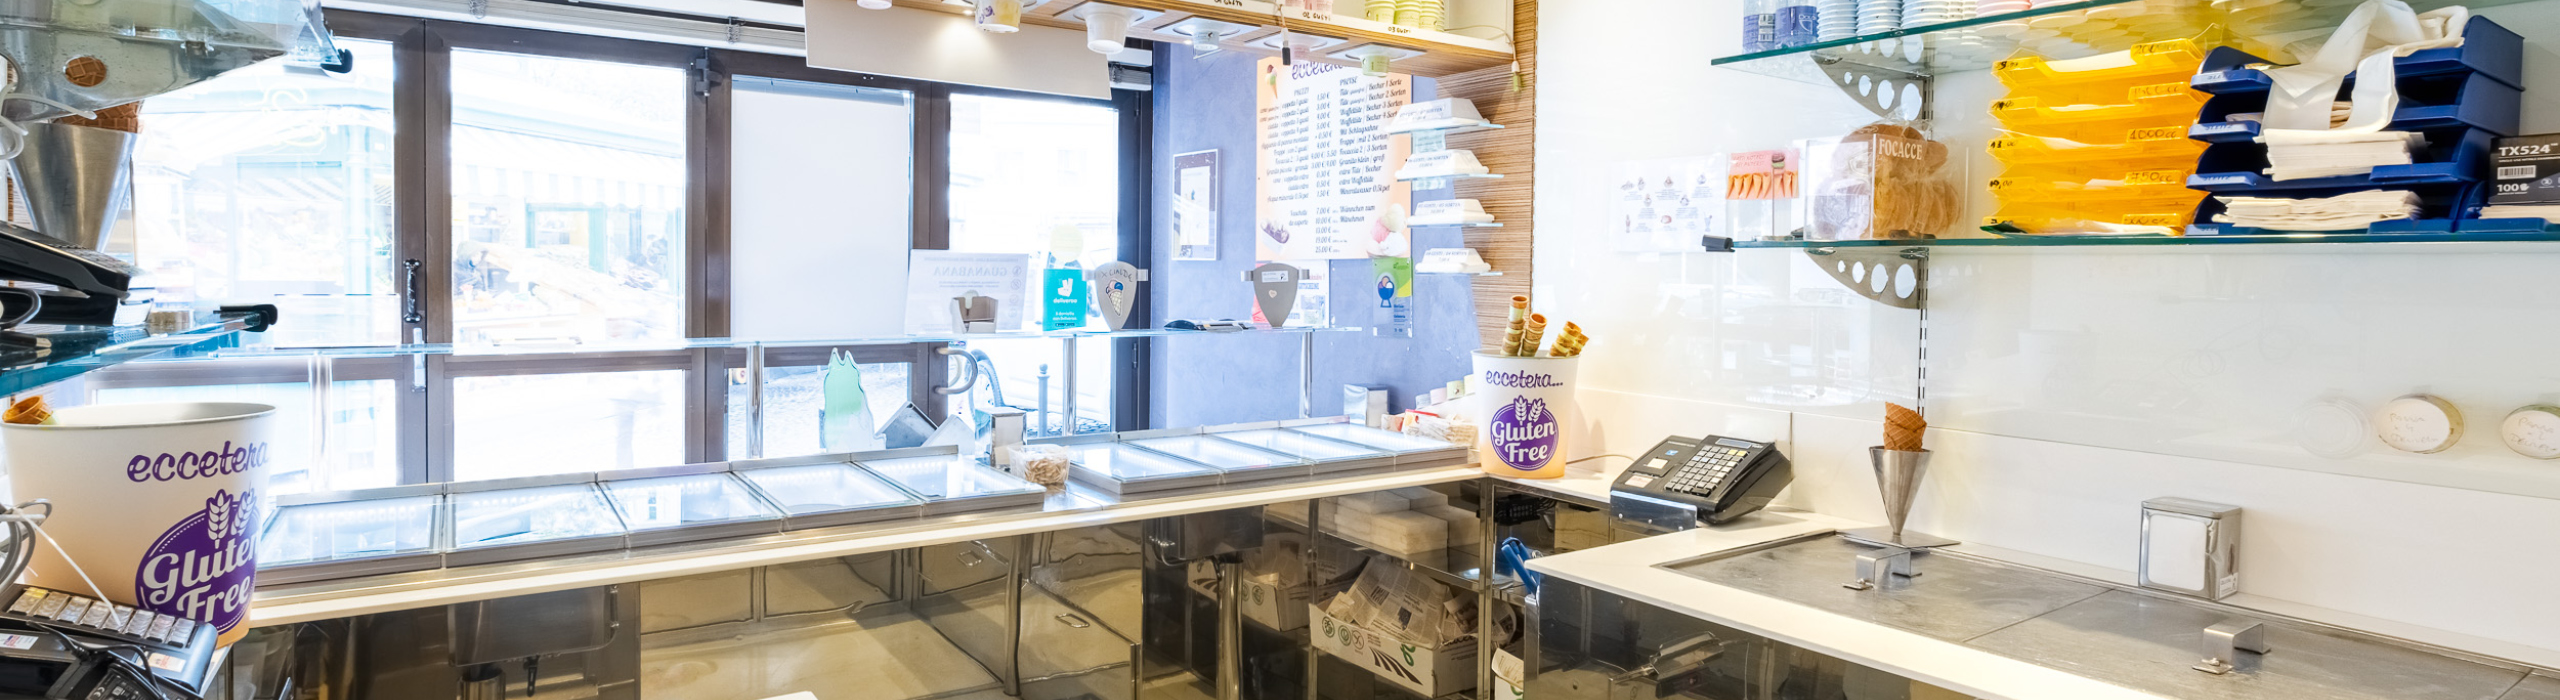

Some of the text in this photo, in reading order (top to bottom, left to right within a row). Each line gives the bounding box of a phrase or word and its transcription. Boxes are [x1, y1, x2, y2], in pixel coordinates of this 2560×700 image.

[1878, 138, 1923, 160] FOCACCE
[2498, 145, 2551, 157] TX524
[2497, 184, 2519, 192] 100
[1491, 421, 1555, 446] Gluten
[1504, 442, 1548, 463] Free
[176, 575, 251, 623] Free
